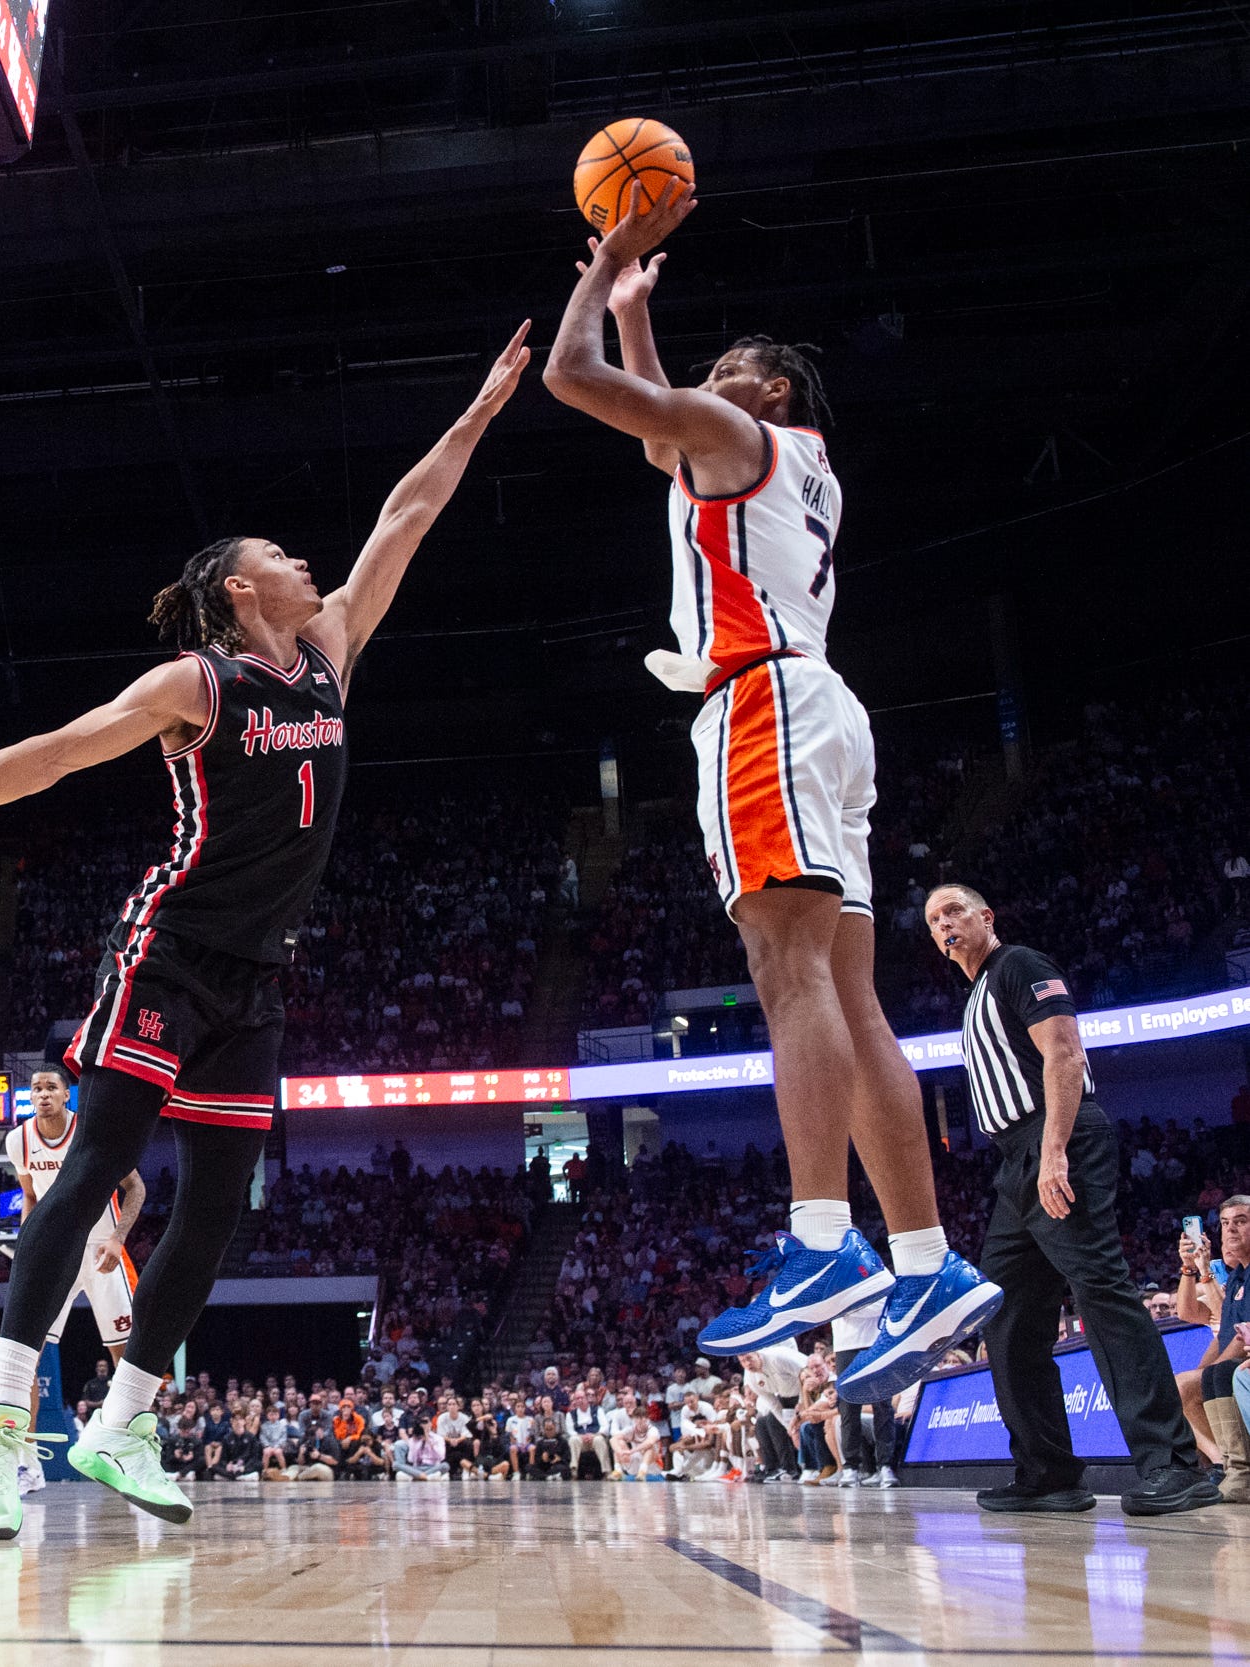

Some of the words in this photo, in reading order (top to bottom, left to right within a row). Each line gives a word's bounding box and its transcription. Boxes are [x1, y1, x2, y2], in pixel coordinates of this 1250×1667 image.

[801, 474, 831, 520] HALL
[805, 512, 833, 600] 7
[240, 706, 343, 757] Houston
[298, 760, 314, 828] 1
[1140, 1002, 1229, 1030] Employee
[298, 1083, 327, 1105] 34
[668, 1066, 739, 1083] Protective
